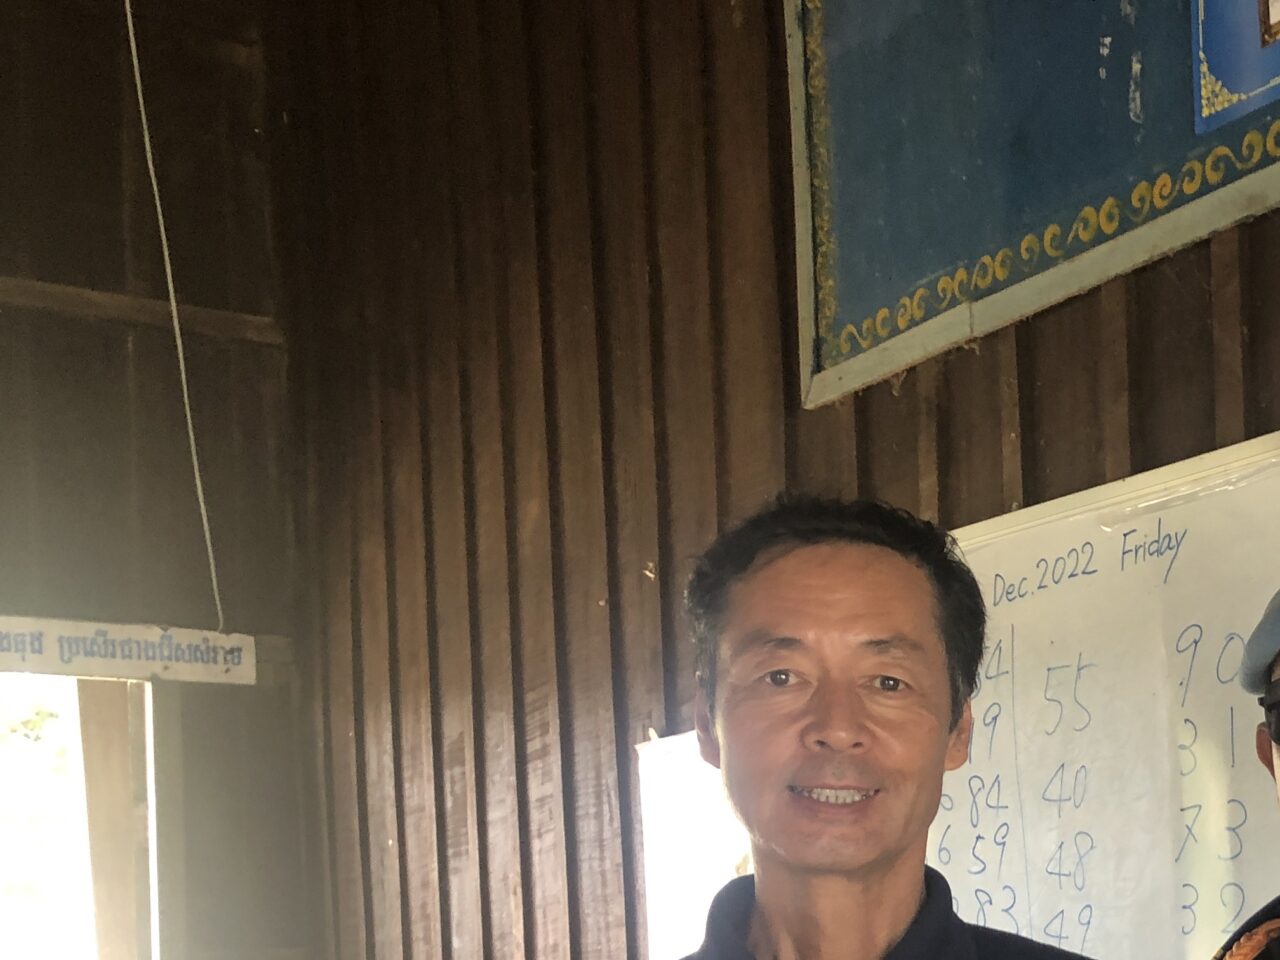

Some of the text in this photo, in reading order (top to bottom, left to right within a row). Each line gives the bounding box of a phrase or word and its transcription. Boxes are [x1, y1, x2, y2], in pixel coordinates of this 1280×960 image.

[1121, 517, 1188, 584] Friday
[1044, 652, 1098, 736] 55
[1177, 705, 1236, 777] 31
[967, 774, 1009, 829] 84
[1042, 763, 1087, 818] 40
[968, 822, 1009, 880] 59
[1174, 798, 1247, 863] 73
[1045, 831, 1097, 891] 48
[1043, 904, 1093, 952] 49
[1181, 882, 1245, 937] 32
